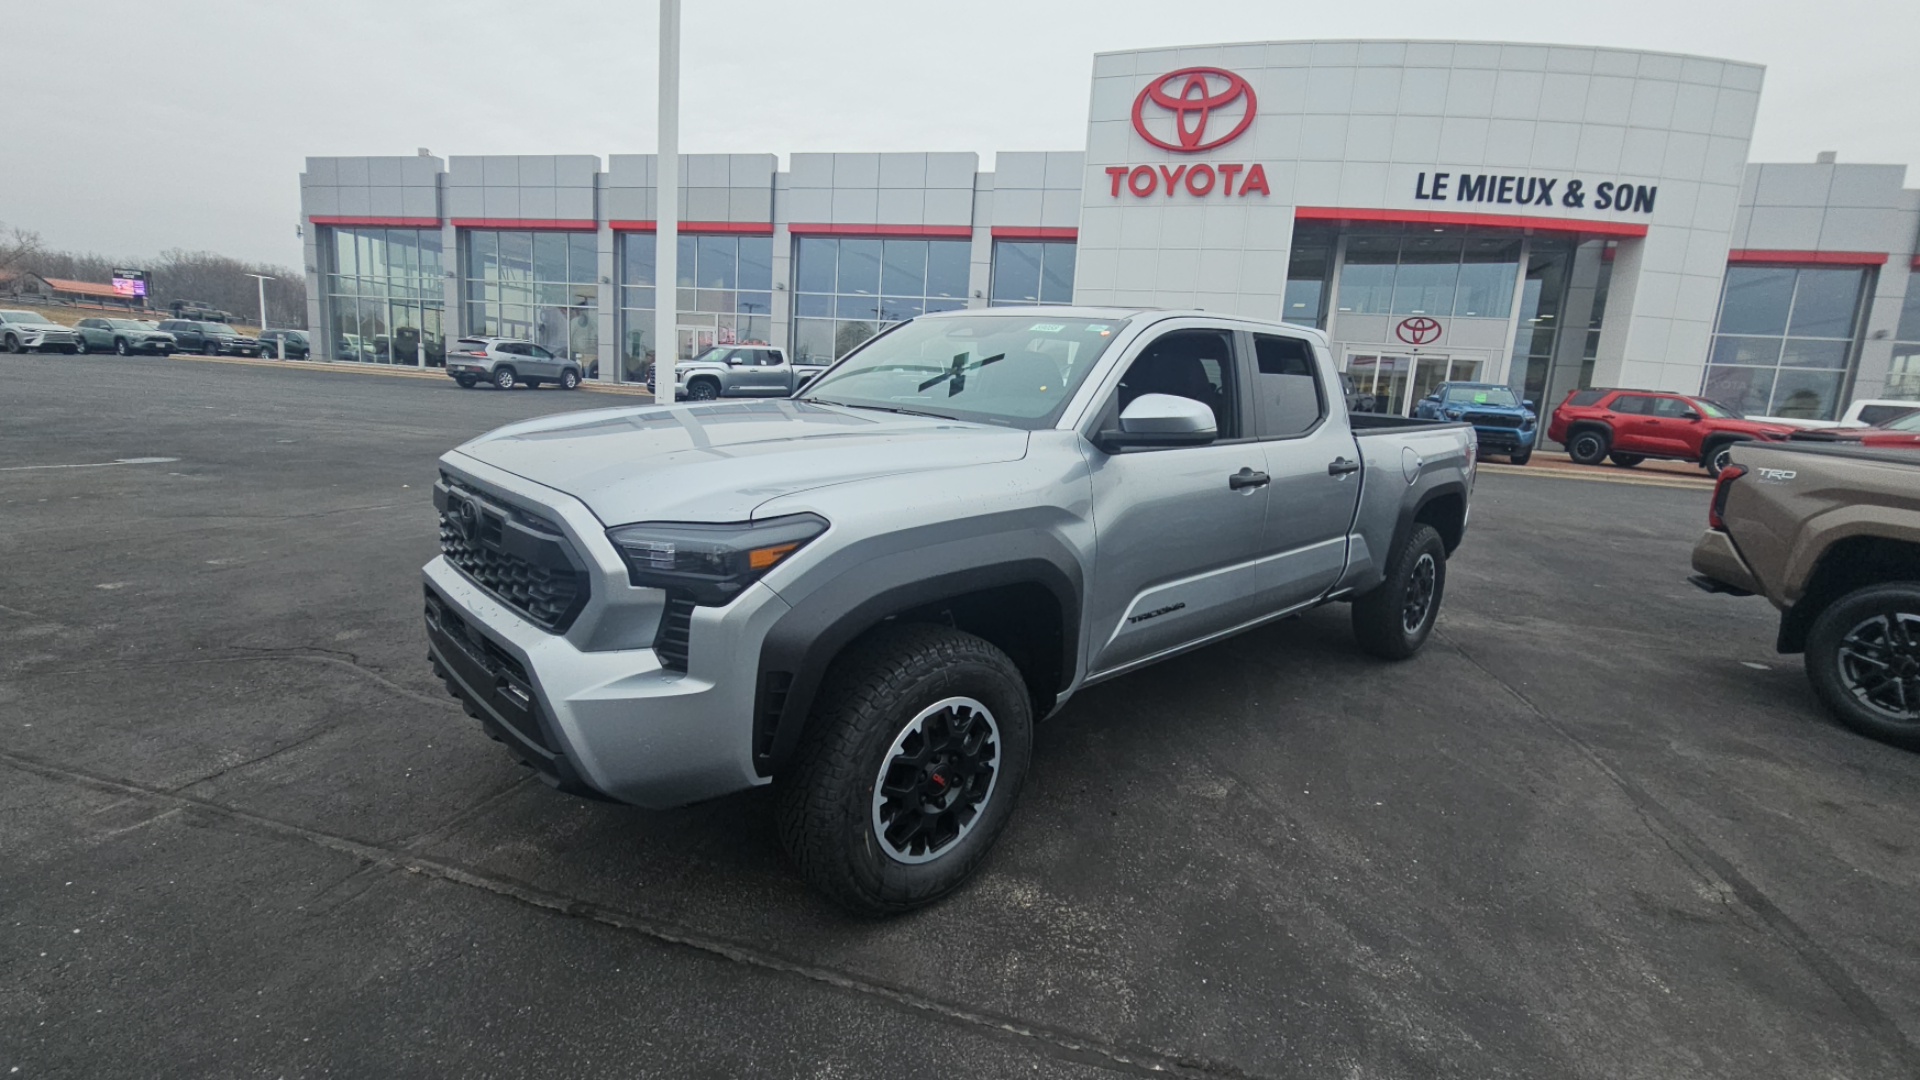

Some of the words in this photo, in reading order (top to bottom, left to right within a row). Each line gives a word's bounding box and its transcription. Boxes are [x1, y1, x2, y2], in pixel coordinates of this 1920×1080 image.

[1105, 163, 1270, 198] TOYOTA
[1415, 171, 1450, 201] LE
[1456, 173, 1558, 207] MIEUX
[1562, 178, 1586, 208] &
[1593, 181, 1658, 214] SON
[1757, 467, 1797, 480] TRD
